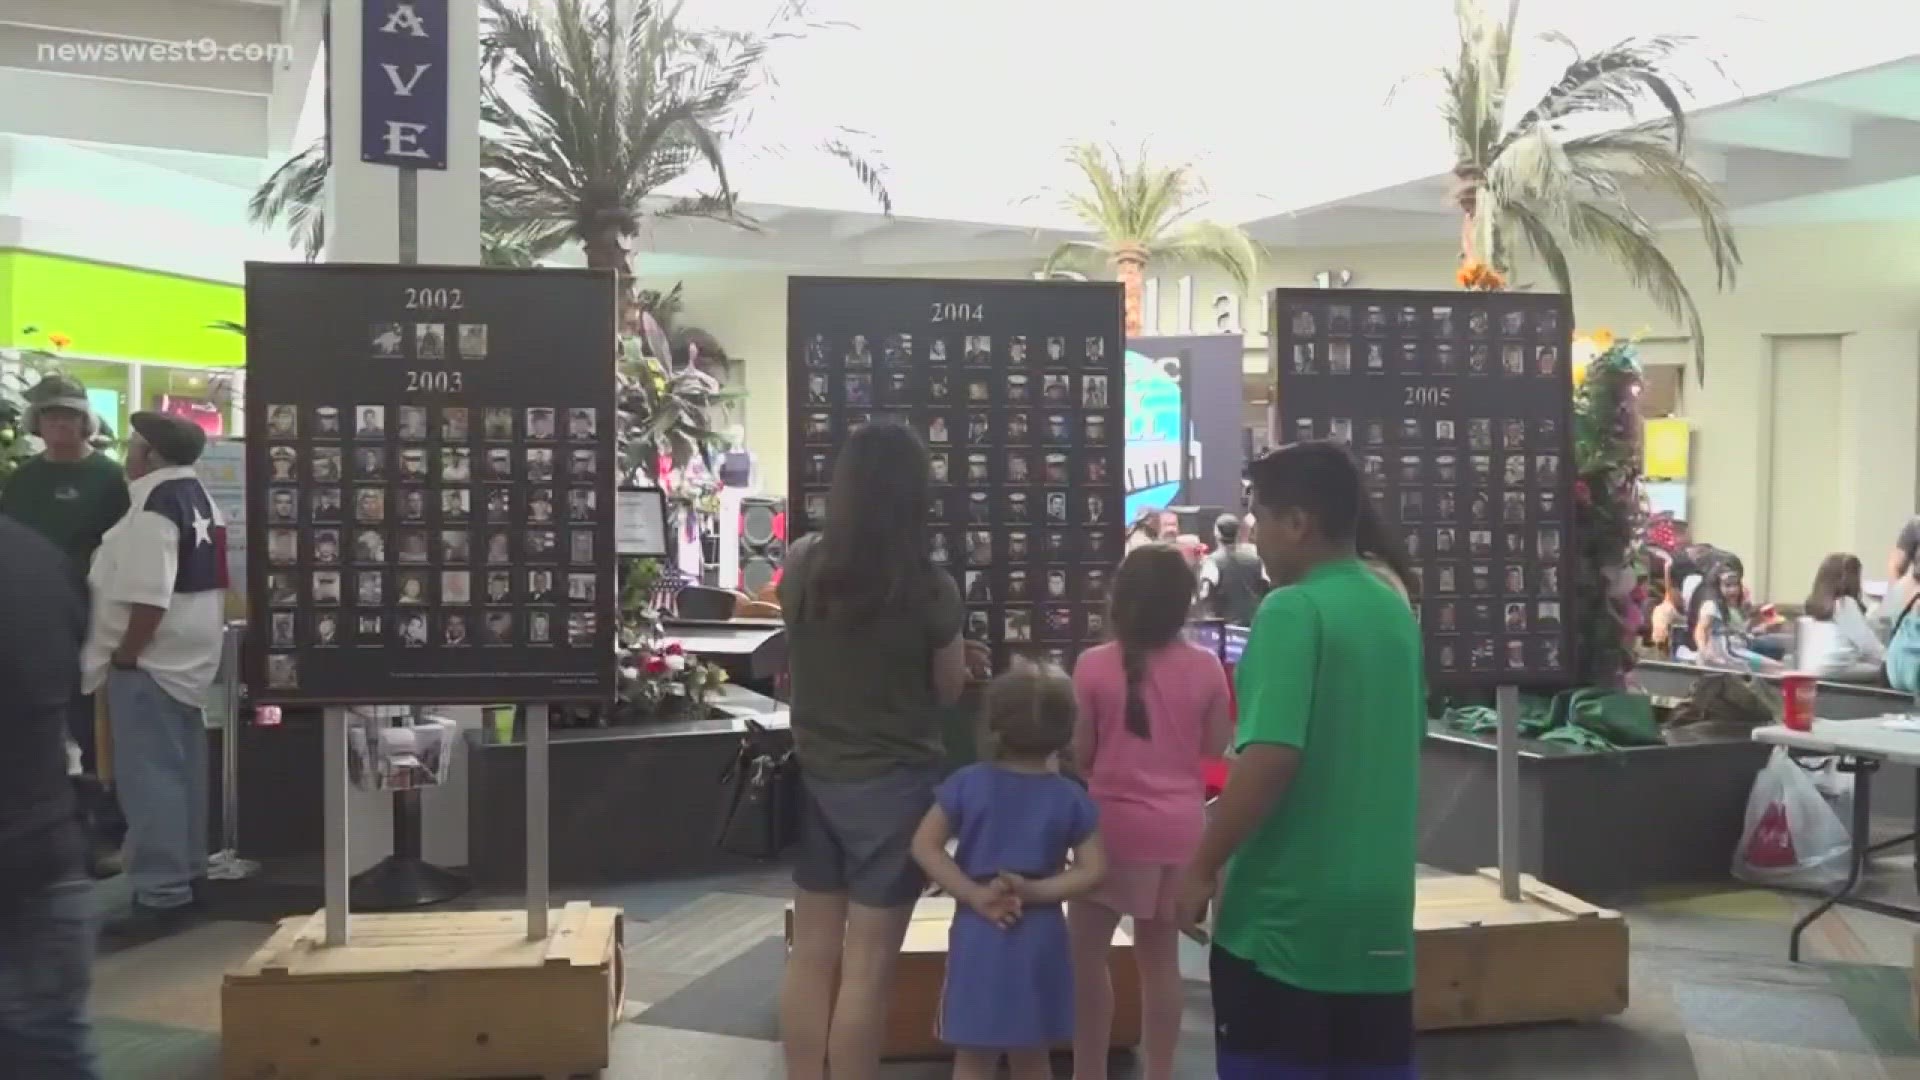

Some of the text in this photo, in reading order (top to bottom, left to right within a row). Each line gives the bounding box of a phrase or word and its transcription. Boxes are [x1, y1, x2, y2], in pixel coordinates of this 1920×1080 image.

[405, 287, 463, 310] 2002
[930, 302, 985, 323] 2004
[406, 371, 463, 393] 2003
[1403, 386, 1451, 407] 2005
